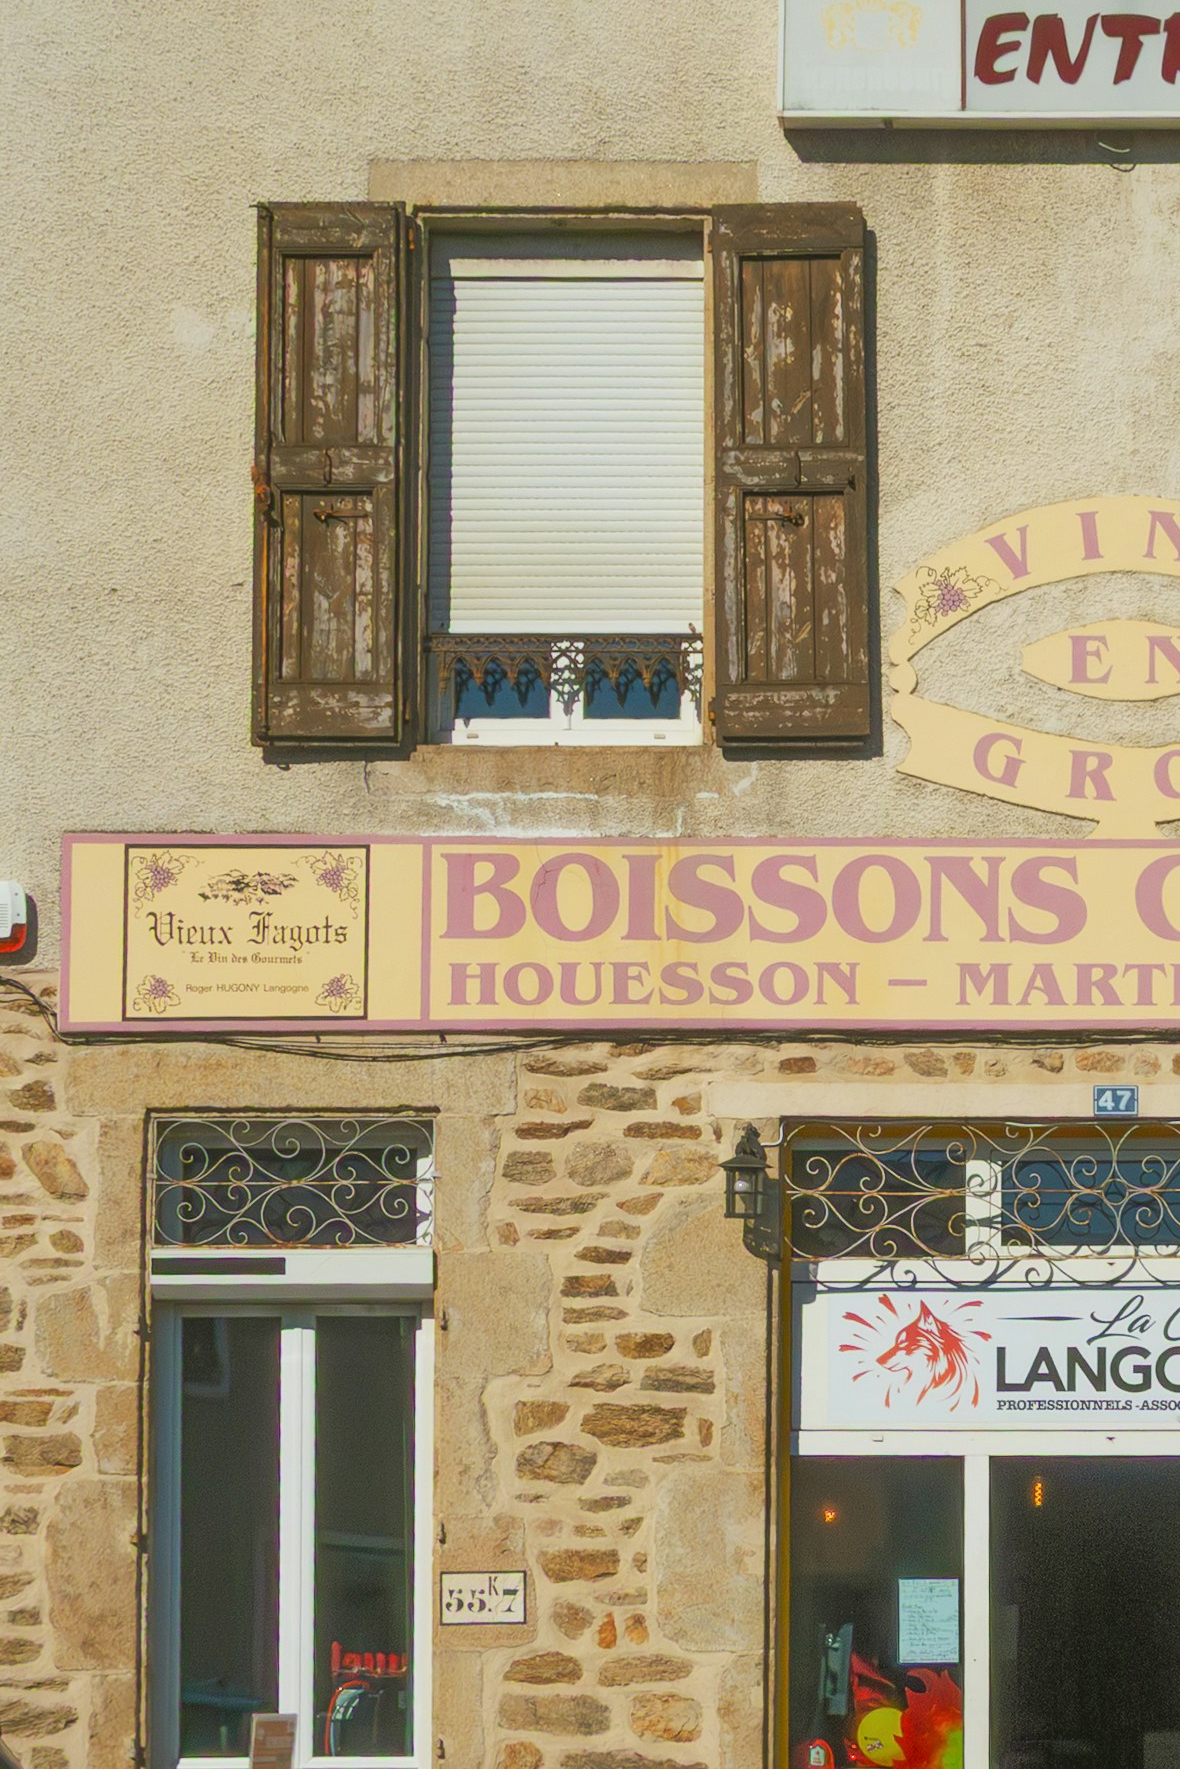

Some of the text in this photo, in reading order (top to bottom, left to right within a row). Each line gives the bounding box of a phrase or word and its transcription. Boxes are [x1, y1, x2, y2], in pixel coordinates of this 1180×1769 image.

[439, 852, 1088, 944] BOISSONS
[146, 911, 348, 952] Vieux Fagots
[231, 953, 248, 964] des
[185, 983, 309, 994] Roger HUGONY Langogne
[447, 961, 860, 1006] HOUESSON
[1098, 1090, 1132, 1111] 47
[1087, 1294, 1154, 1346] La
[996, 1399, 1133, 1412] PROFESSIONNELS
